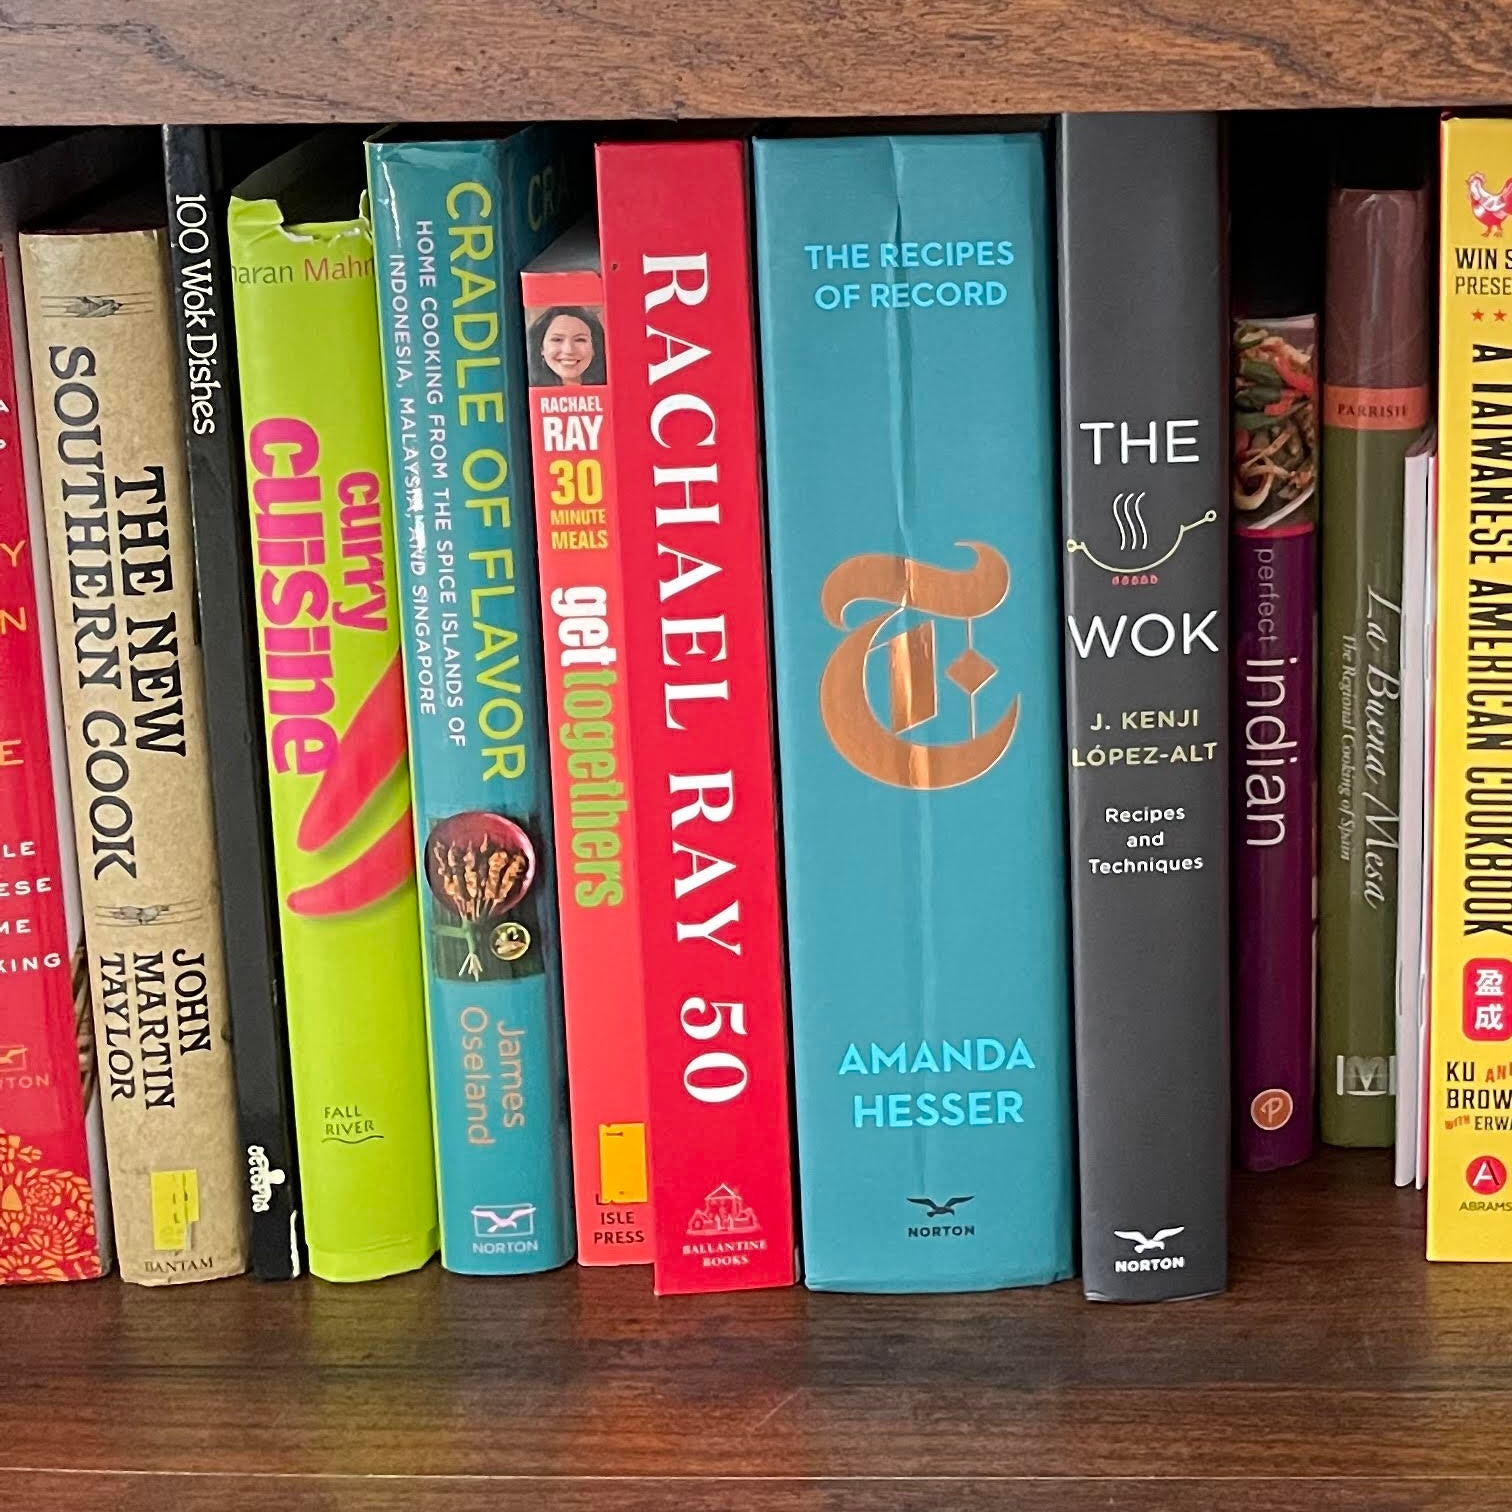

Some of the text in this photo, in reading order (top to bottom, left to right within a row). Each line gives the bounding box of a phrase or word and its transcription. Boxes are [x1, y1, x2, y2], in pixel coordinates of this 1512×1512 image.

[805, 240, 1014, 270] THE RECIPES
[1455, 249, 1500, 270] WIN
[815, 282, 1007, 309] OF RECORD
[175, 194, 216, 436] 100 Wok Dishes
[540, 396, 603, 413] RACHAEL
[542, 416, 603, 452] RAY
[1080, 418, 1199, 465] THE
[416, 220, 465, 747] HOME COOKING FROM THE SPICE ISLANDS OF
[446, 181, 527, 782] CRADLE OF FLAVOR
[549, 459, 603, 506] 30
[550, 509, 606, 525] MINUTE
[332, 471, 388, 632] curry
[551, 529, 608, 550] MEALS
[48, 345, 138, 881] SOUTHERN COOK
[114, 466, 187, 758] THE NEW
[248, 417, 338, 774] cuisine
[1067, 611, 1219, 659] WOK
[642, 251, 750, 1104] RACHAEL RAY 50
[1245, 656, 1298, 847] indian
[1105, 805, 1185, 825] Recipes
[1126, 832, 1164, 848] and
[1088, 854, 1204, 875] Techniques
[173, 948, 212, 1053] JOHN
[99, 954, 137, 1101] TAYLOR
[133, 952, 176, 1111] MARTIN
[839, 1037, 1035, 1075] AMANDA
[324, 1106, 363, 1120] FALL
[325, 1120, 375, 1136] RIVER
[854, 1092, 1024, 1128] HESSER
[1459, 1201, 1512, 1212] ABRAMS
[472, 1241, 538, 1254] NORTON
[908, 1225, 975, 1237] NORTON
